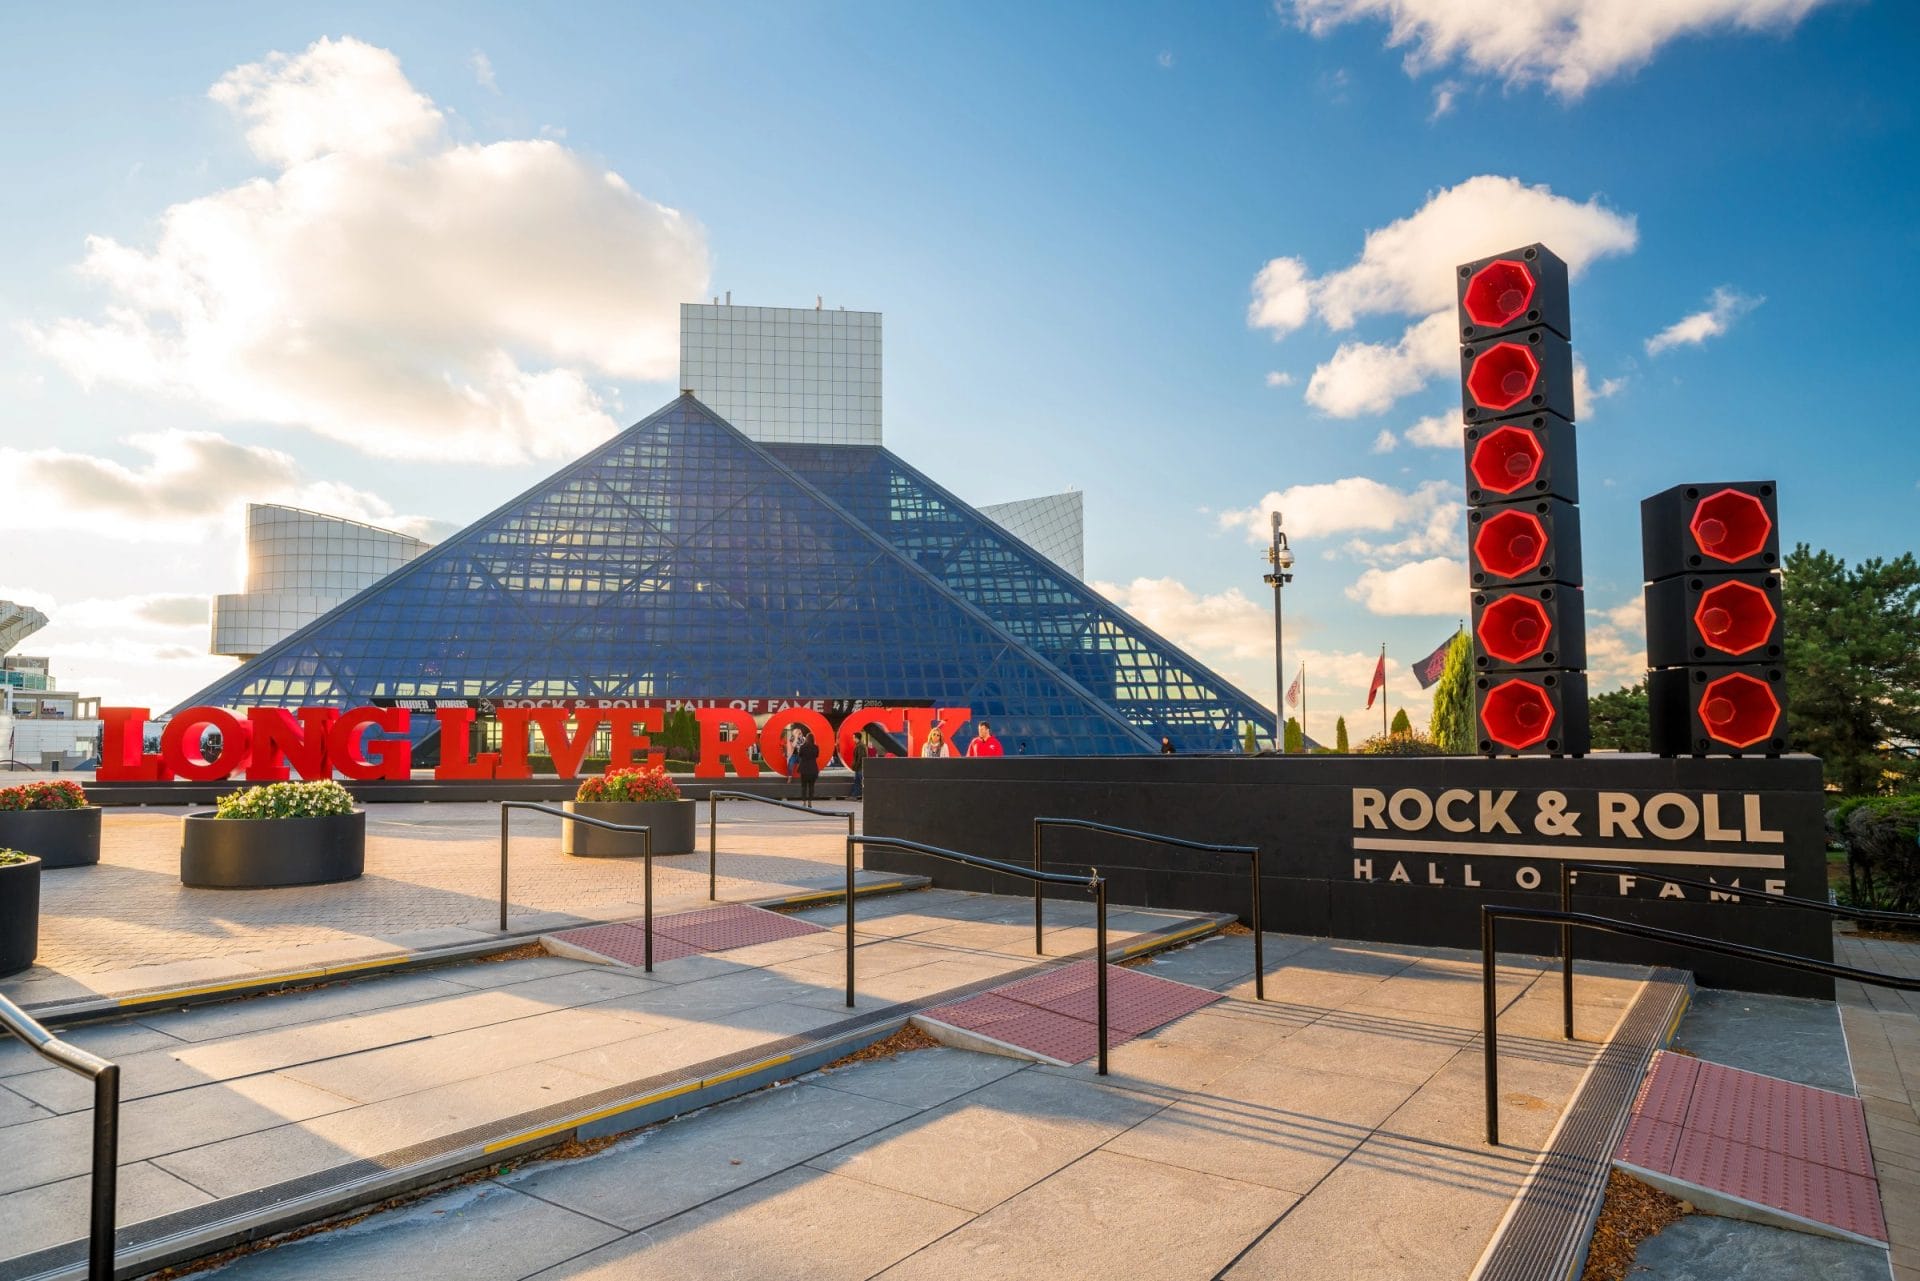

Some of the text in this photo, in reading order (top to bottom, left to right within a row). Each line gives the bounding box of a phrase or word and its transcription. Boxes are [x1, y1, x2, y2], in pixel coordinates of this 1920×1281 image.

[503, 700, 566, 709] ROCK
[575, 700, 590, 709] &
[729, 700, 760, 713] OF
[767, 700, 825, 713] FAME
[96, 706, 972, 782] LONG LIVE ROCK
[1352, 787, 1785, 844] ROCK & ROLL
[1353, 858, 1481, 888] HALL
